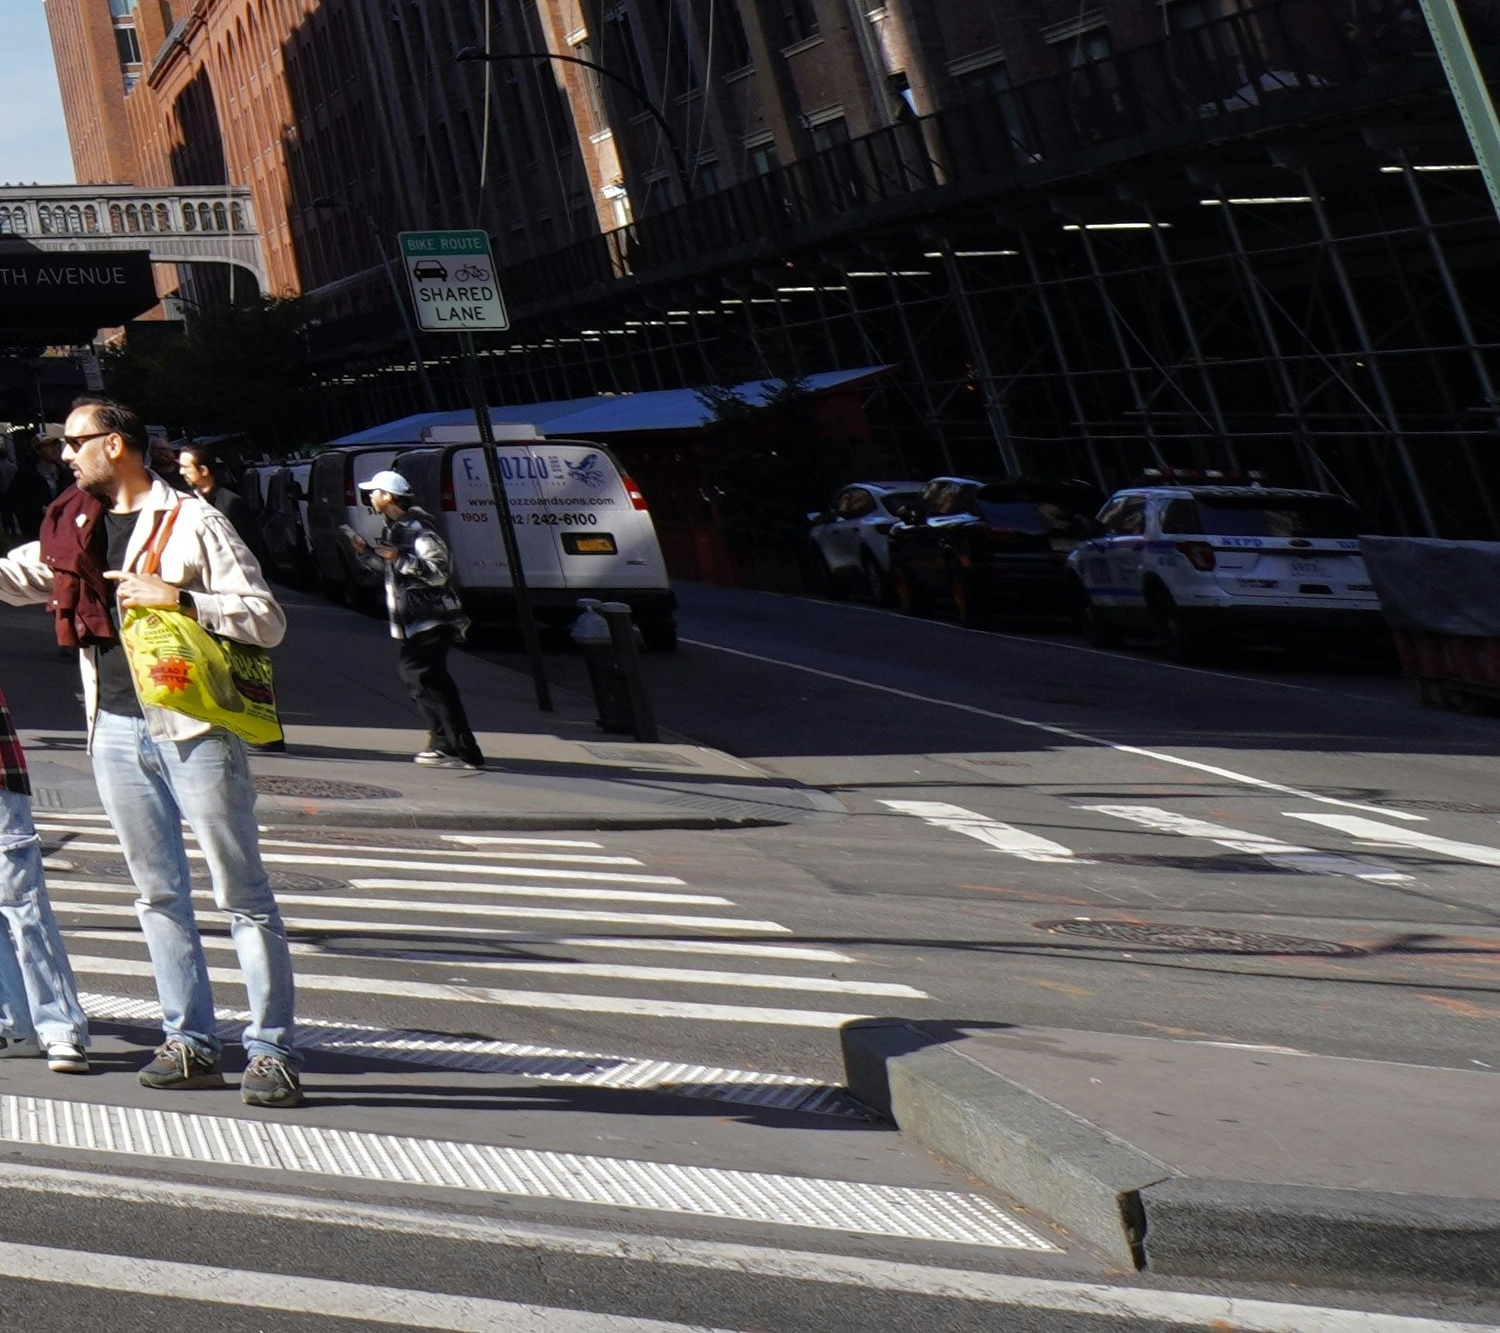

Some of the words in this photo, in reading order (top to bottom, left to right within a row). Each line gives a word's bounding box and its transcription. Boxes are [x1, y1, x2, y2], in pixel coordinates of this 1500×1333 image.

[407, 238, 436, 251] BIKE
[440, 237, 482, 250] ROUTE
[36, 267, 126, 285] AVENUE
[420, 286, 493, 303] SHARED
[436, 306, 486, 321] LANE
[500, 456, 549, 480] OZZO
